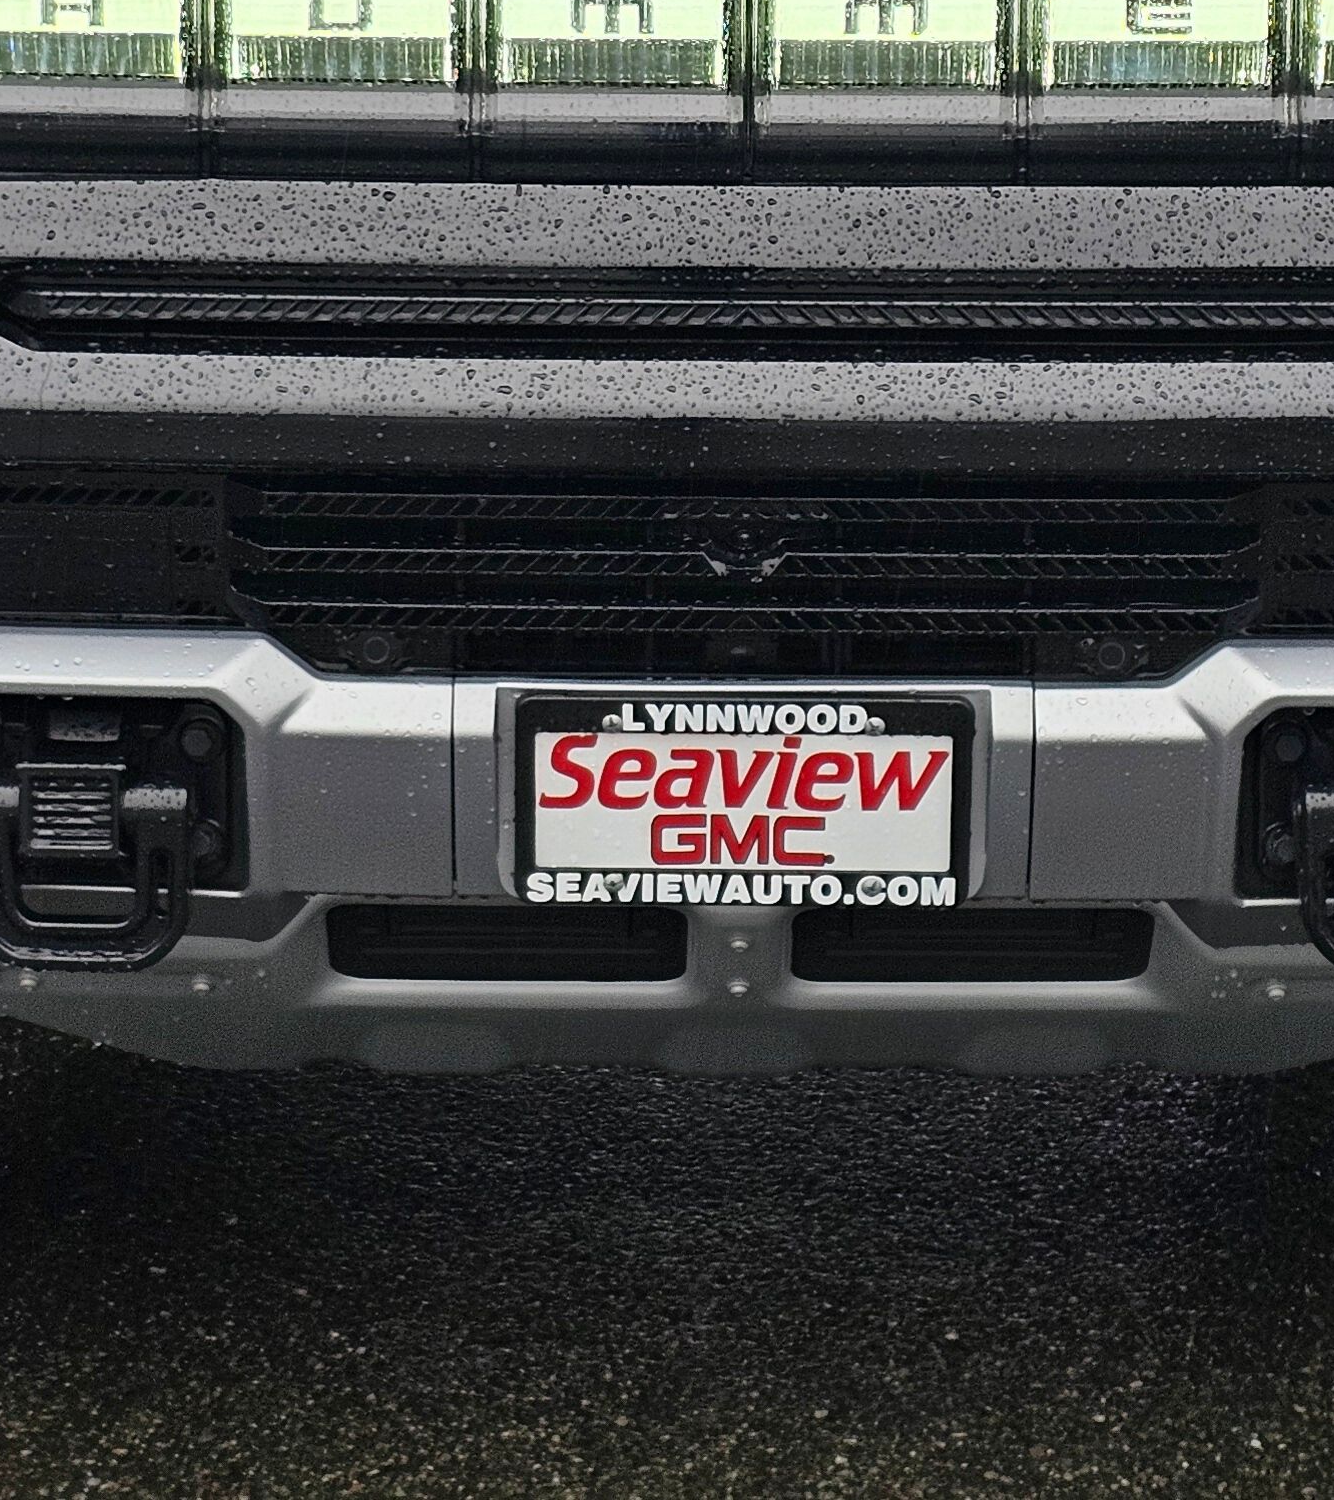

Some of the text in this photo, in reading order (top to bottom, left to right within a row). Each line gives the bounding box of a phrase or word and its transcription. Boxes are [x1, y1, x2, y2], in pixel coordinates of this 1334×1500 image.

[621, 703, 868, 734] LYNNWOOD
[538, 733, 950, 812] Seaview
[650, 813, 827, 866] GMC
[526, 872, 956, 907] SEAVIEWAUTO.COM
